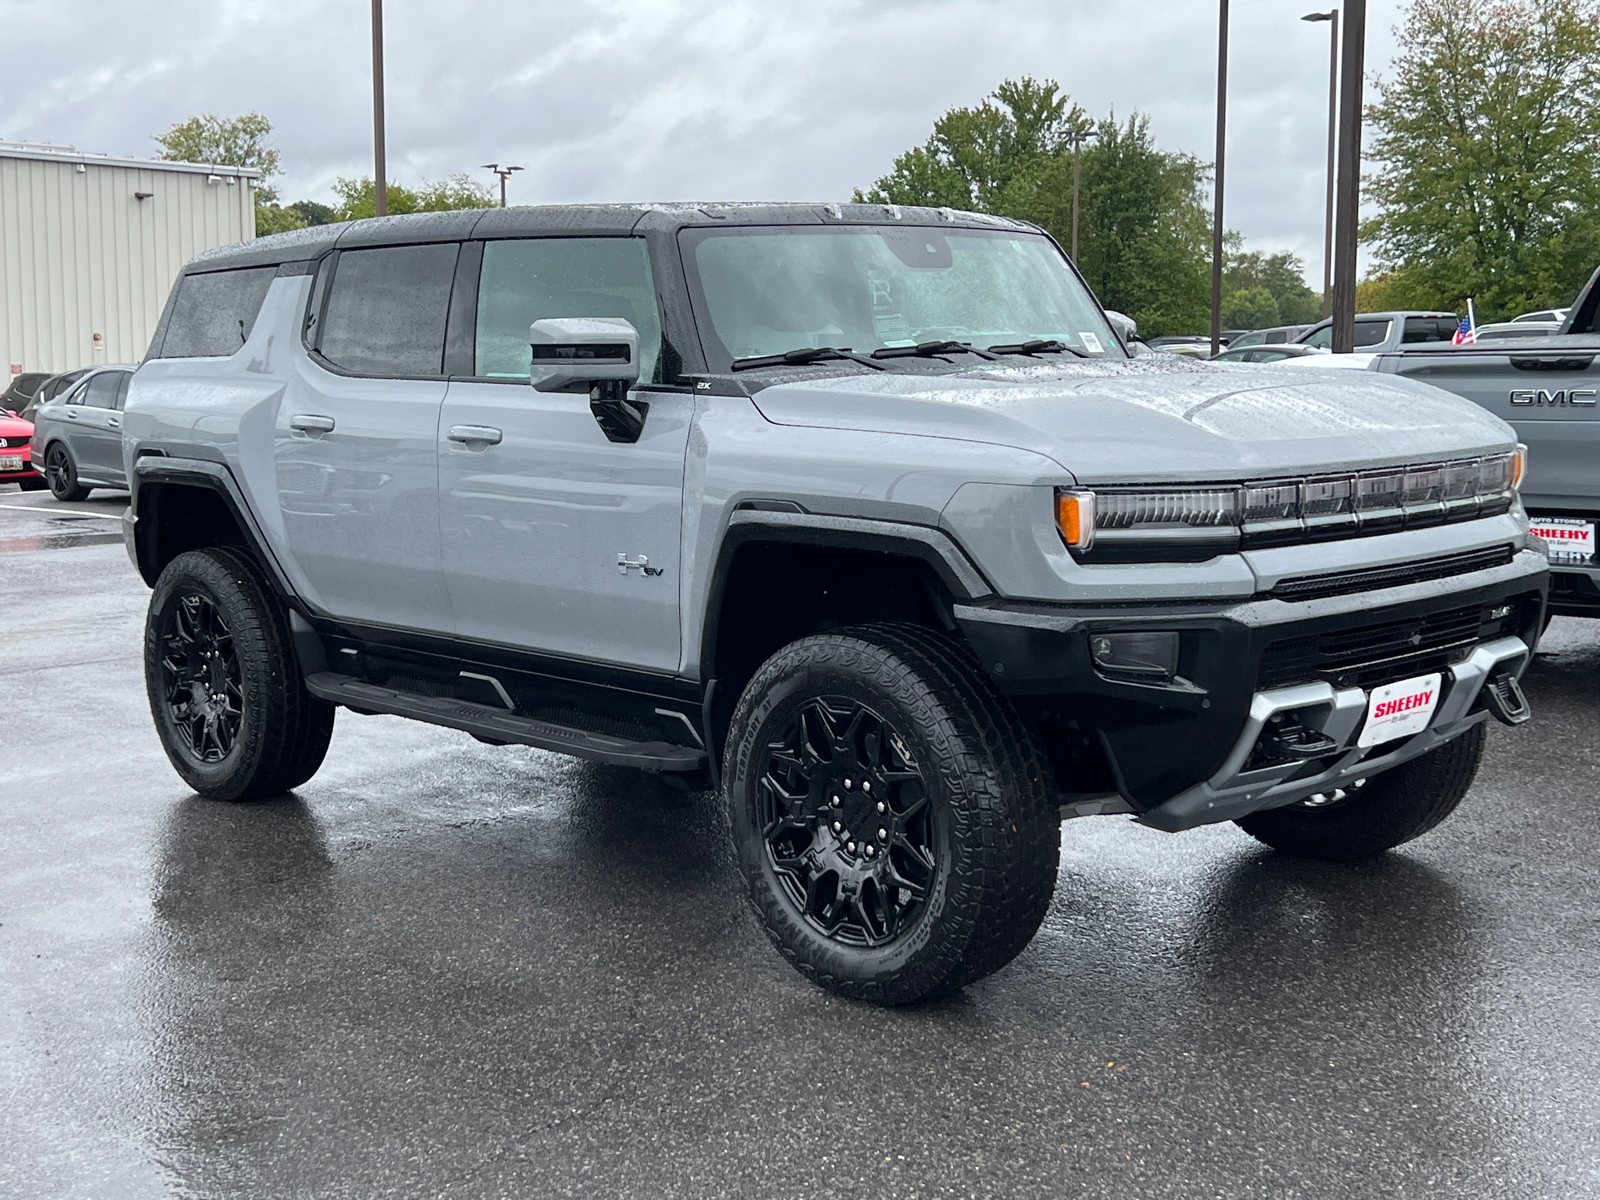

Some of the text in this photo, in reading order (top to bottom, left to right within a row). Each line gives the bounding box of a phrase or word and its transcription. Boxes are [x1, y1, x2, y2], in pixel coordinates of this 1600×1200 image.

[697, 381, 712, 390] 2X
[1509, 389, 1597, 407] GMC
[1528, 527, 1589, 540] SHEEHY
[1374, 689, 1433, 718] SHEEHY
[737, 698, 773, 782] TERRITORY AT
